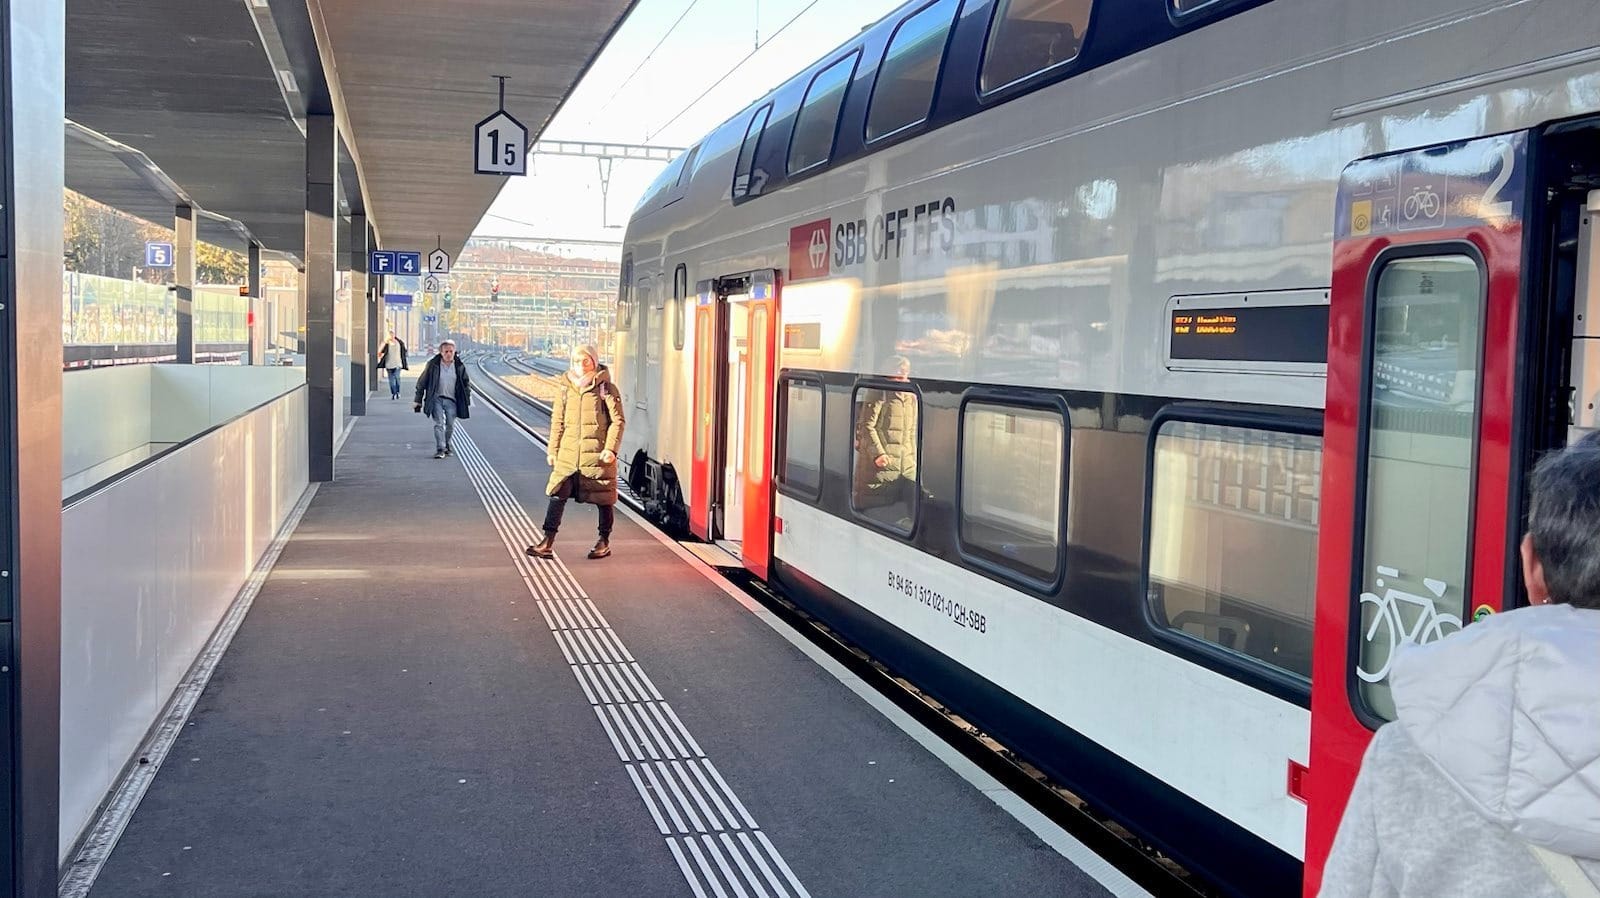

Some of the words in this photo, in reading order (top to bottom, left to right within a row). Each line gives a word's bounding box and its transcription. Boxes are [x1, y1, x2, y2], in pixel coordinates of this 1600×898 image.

[1477, 142, 1515, 218] 2
[835, 220, 867, 267] SBB
[872, 208, 909, 262] CFF
[913, 196, 955, 256] FFS
[155, 250, 165, 263] 5
[435, 256, 443, 270] 2
[379, 258, 388, 271] F
[404, 259, 413, 272] 4
[896, 575, 904, 592] 94
[919, 586, 932, 606] 512
[932, 593, 952, 617] 021-0
[954, 603, 986, 633] CH-SBB
